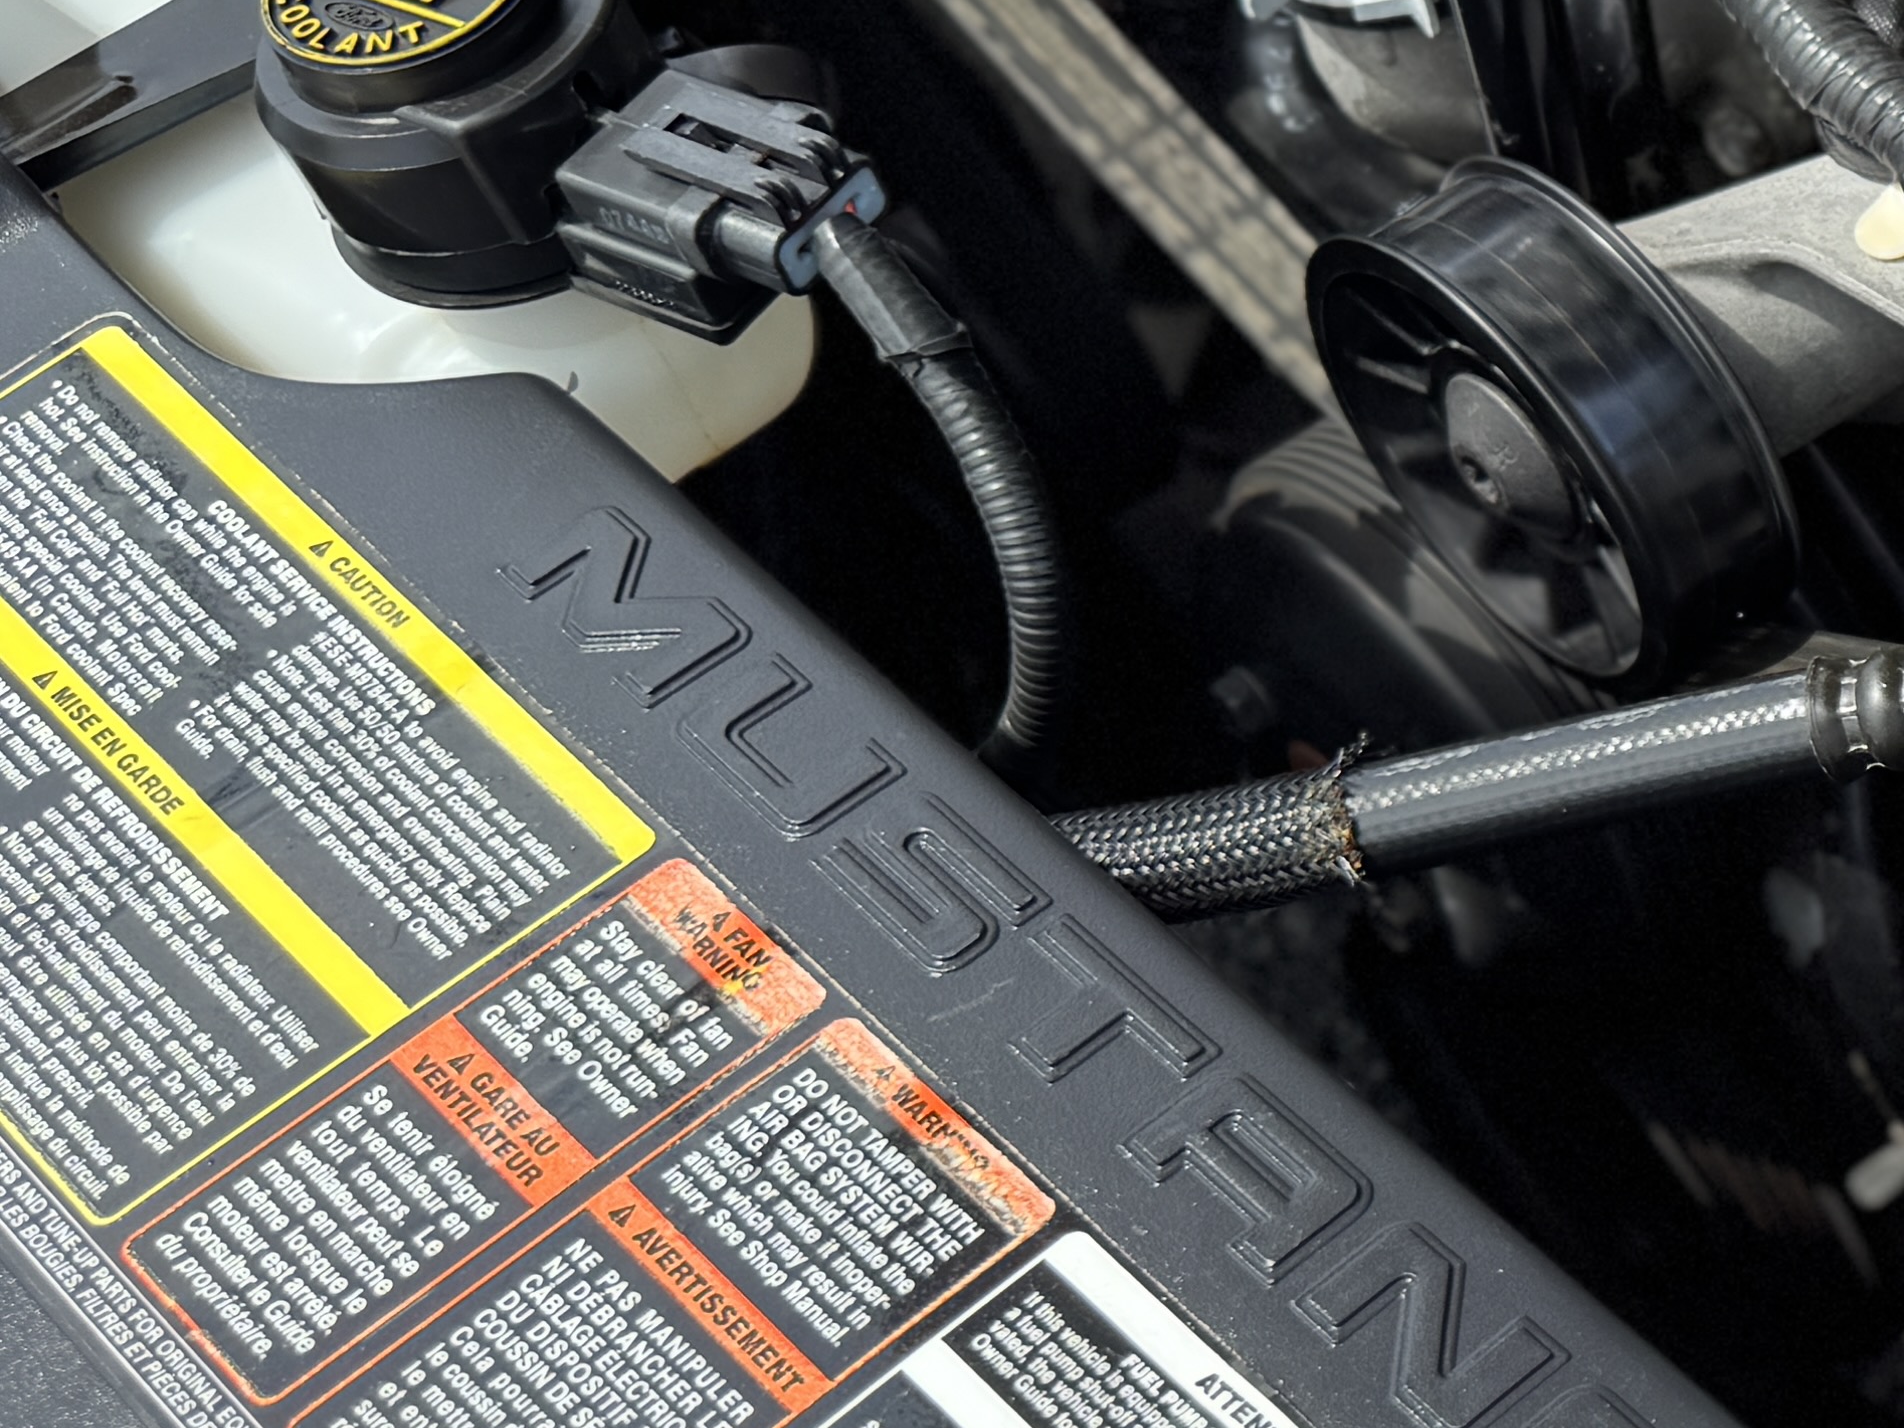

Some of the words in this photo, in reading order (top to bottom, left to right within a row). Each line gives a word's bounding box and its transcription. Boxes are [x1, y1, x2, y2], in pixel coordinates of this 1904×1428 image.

[207, 500, 277, 562] COOLANT
[269, 559, 336, 620] SERVICE
[328, 615, 434, 714] INSTRUCTIONS
[329, 556, 409, 627] CAUTION
[50, 685, 101, 731] MISE
[90, 726, 126, 756] EN
[116, 753, 184, 814] GARDE
[723, 927, 771, 967] FAN
[413, 1054, 542, 1186] VENTILATEUR
[470, 1071, 530, 1130] GARE
[519, 1127, 560, 1156] AU
[771, 1084, 807, 1115] OR
[801, 1112, 922, 1220] DISCONNECT
[916, 1217, 962, 1260] THE
[792, 1067, 828, 1098] DO
[820, 1094, 868, 1133] NOT
[860, 1128, 935, 1199] TAMPER
[929, 1193, 984, 1244] WITH
[564, 1238, 603, 1273] NE
[595, 1269, 641, 1311] PAS
[636, 1309, 753, 1423] MANIPULER
[633, 1228, 803, 1390] AVERTISSEMENT
[156, 1339, 224, 1411] ORIGINAL
[1120, 1353, 1164, 1396] FUEL
